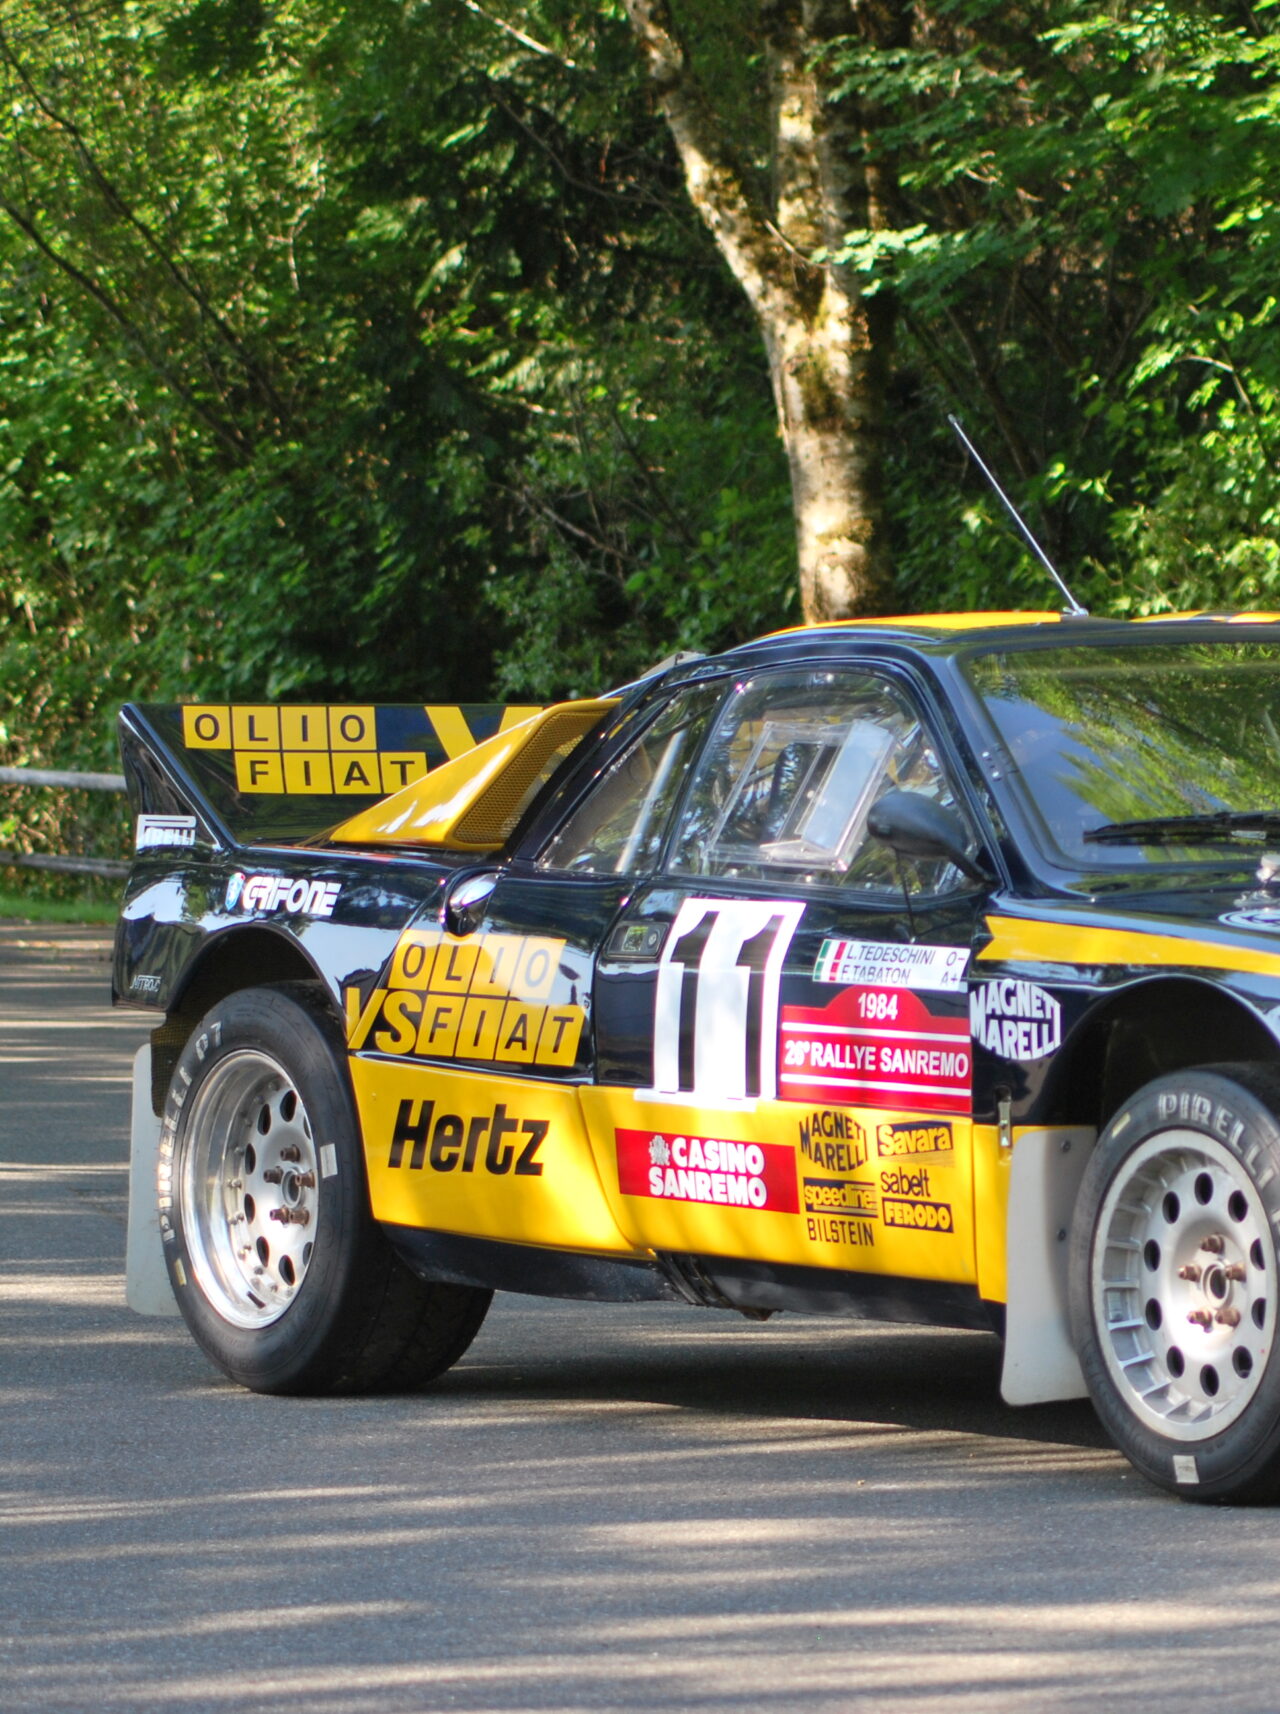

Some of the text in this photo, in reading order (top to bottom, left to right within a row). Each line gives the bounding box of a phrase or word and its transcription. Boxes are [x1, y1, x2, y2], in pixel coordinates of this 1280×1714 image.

[195, 712, 365, 742] OLIO
[249, 759, 415, 787] FIAT
[242, 875, 342, 916] GRIFONE
[402, 942, 550, 988] OLIO
[666, 909, 788, 1099] 11
[858, 993, 898, 1020] 1984
[428, 1007, 574, 1054] FIAT
[880, 1047, 969, 1078] SANREMO
[388, 1100, 549, 1176] Hertz
[878, 1124, 952, 1156] Savara
[1158, 1092, 1275, 1190] PIRELLI
[672, 1137, 765, 1176] CASINO
[649, 1166, 767, 1207] SANREMO
[880, 1166, 931, 1198] sabelt
[807, 1217, 875, 1247] BILSTEIN
[884, 1200, 951, 1230] FERODO
